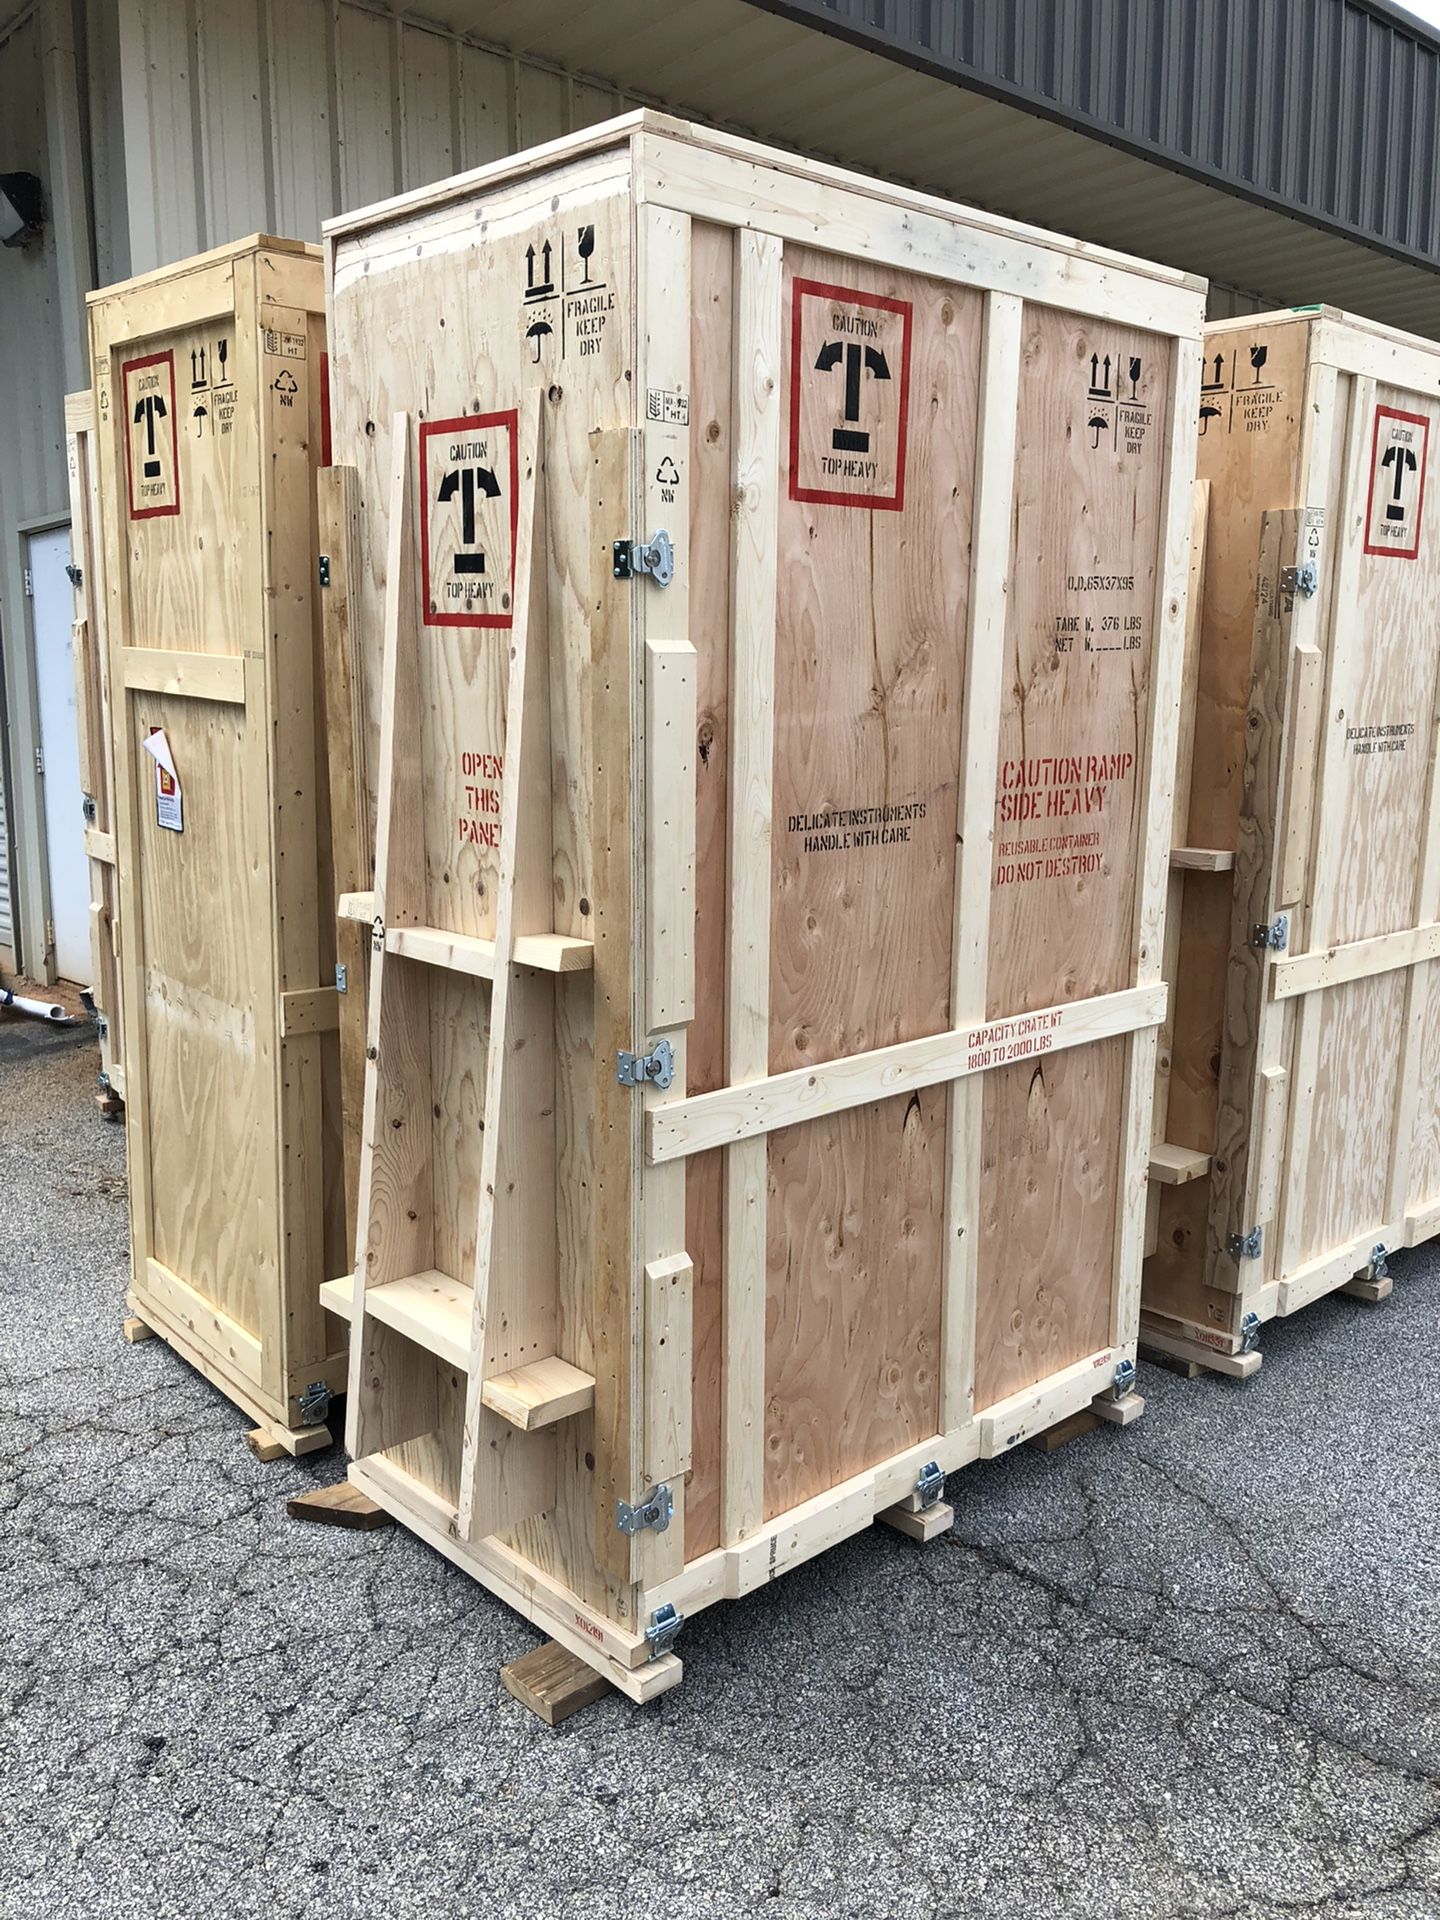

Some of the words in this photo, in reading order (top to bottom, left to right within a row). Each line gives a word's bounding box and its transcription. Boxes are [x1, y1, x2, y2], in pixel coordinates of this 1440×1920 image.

[567, 293, 615, 318] FRAGILE
[576, 316, 606, 337] KEEP
[832, 314, 879, 338] CAUTION
[580, 337, 602, 356] DRY
[138, 374, 160, 391] CAUTION
[213, 390, 238, 407] FRAGILE
[1236, 391, 1283, 406] FRAGILE
[218, 407, 235, 421] KEEP
[1119, 410, 1152, 426] FRAGILE
[1243, 406, 1273, 419] KEEP
[221, 421, 233, 435] DRY
[1124, 426, 1146, 440] KEEP
[1246, 420, 1268, 432] DRY
[1391, 427, 1413, 443] CAUTION
[450, 441, 487, 461] CAUTION
[1126, 441, 1143, 455] DRY
[821, 457, 842, 476] TOP
[843, 459, 879, 479] HEAVY
[141, 484, 150, 497] TOP
[150, 482, 166, 496] HEAVY
[1380, 524, 1391, 537] TOP
[1391, 525, 1408, 538] HEAVY
[446, 582, 463, 598] TOP
[464, 582, 494, 599] HEAVY
[1056, 616, 1079, 632] TARE
[1101, 616, 1120, 631] 376
[1124, 616, 1142, 631] LBS
[1055, 637, 1074, 652] NET
[1346, 726, 1376, 740] DELICATE
[1376, 723, 1415, 738] INSTRUMENTS
[1353, 742, 1377, 755] HANDLE
[1377, 740, 1391, 753] WITH
[1391, 739, 1407, 752] CARE
[462, 752, 503, 780] OPEN
[1002, 757, 1082, 790] CAUTION
[1086, 753, 1133, 783] RAMP
[465, 785, 500, 814] THIS
[1001, 790, 1043, 822] SIDE
[1046, 785, 1107, 818] HEAVY
[788, 810, 846, 833] DELICATE
[847, 803, 927, 827] INSTRUMENTS
[804, 832, 851, 853] HANDLE
[853, 830, 879, 848] WITH
[881, 826, 912, 845] CARE
[998, 837, 1048, 857] REUSABLE
[1049, 832, 1100, 851] CONTAINER
[996, 864, 1015, 886] DO
[1016, 860, 1043, 882] NOT
[1045, 852, 1103, 879] DESTROY
[968, 1022, 1017, 1049] CAPACITY
[1018, 1014, 1049, 1036] CRATE
[1050, 1011, 1063, 1028] WT
[967, 1050, 991, 1070] 1800
[992, 1046, 1006, 1063] TO
[1007, 1039, 1032, 1060] 2000
[1033, 1034, 1053, 1053] LBS
